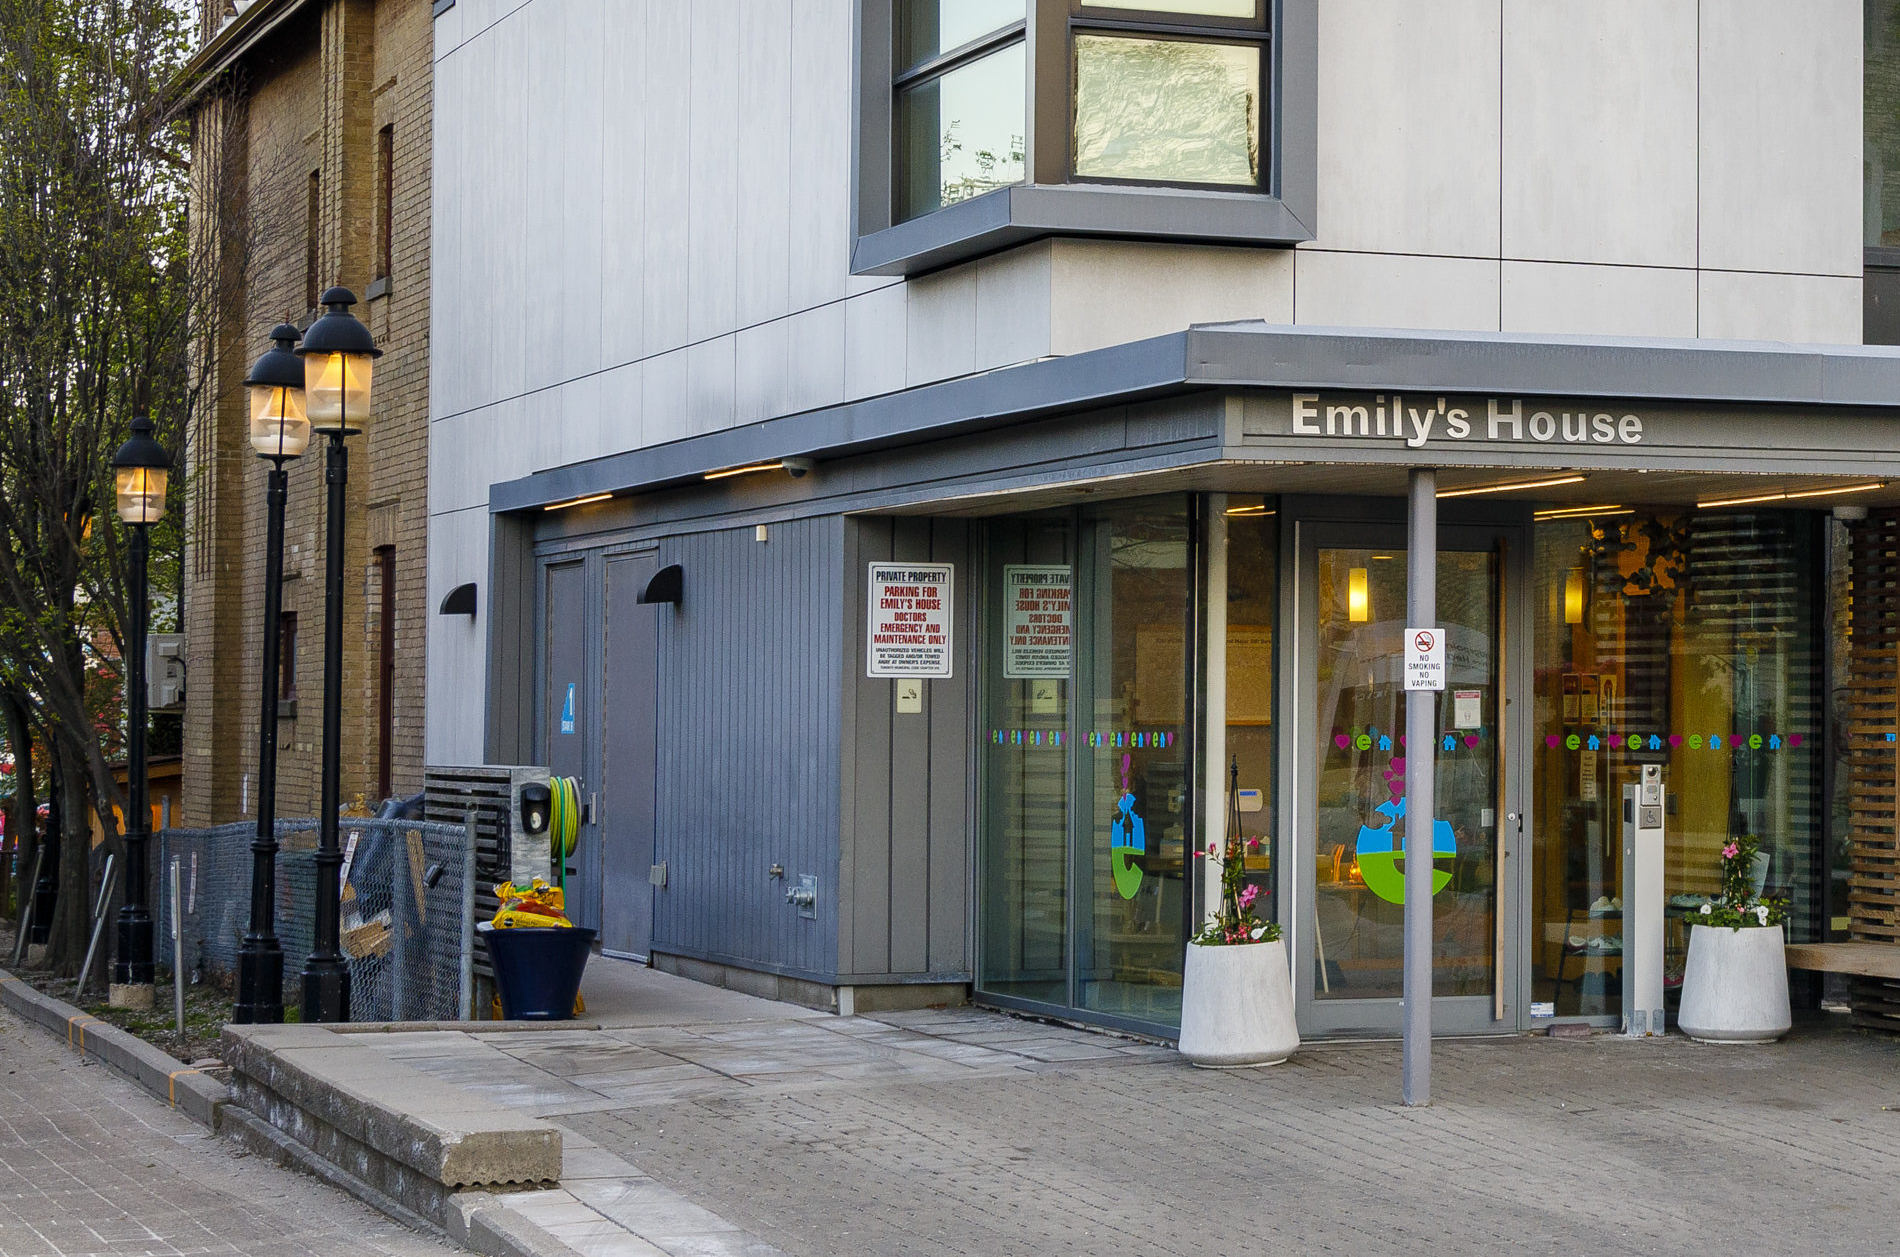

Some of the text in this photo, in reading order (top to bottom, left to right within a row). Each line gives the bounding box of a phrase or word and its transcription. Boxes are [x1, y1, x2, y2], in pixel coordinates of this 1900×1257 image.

[1292, 393, 1643, 448] Emily's House
[876, 571, 946, 582] PRIVATE PROPERTY
[884, 586, 937, 597] PARKING FOR
[880, 598, 941, 610] EMILY'S HOUSE
[894, 612, 927, 622] DOCTORS
[880, 623, 940, 633] EMERGENCY AND
[874, 634, 946, 645] MAINTENANCE ONLY
